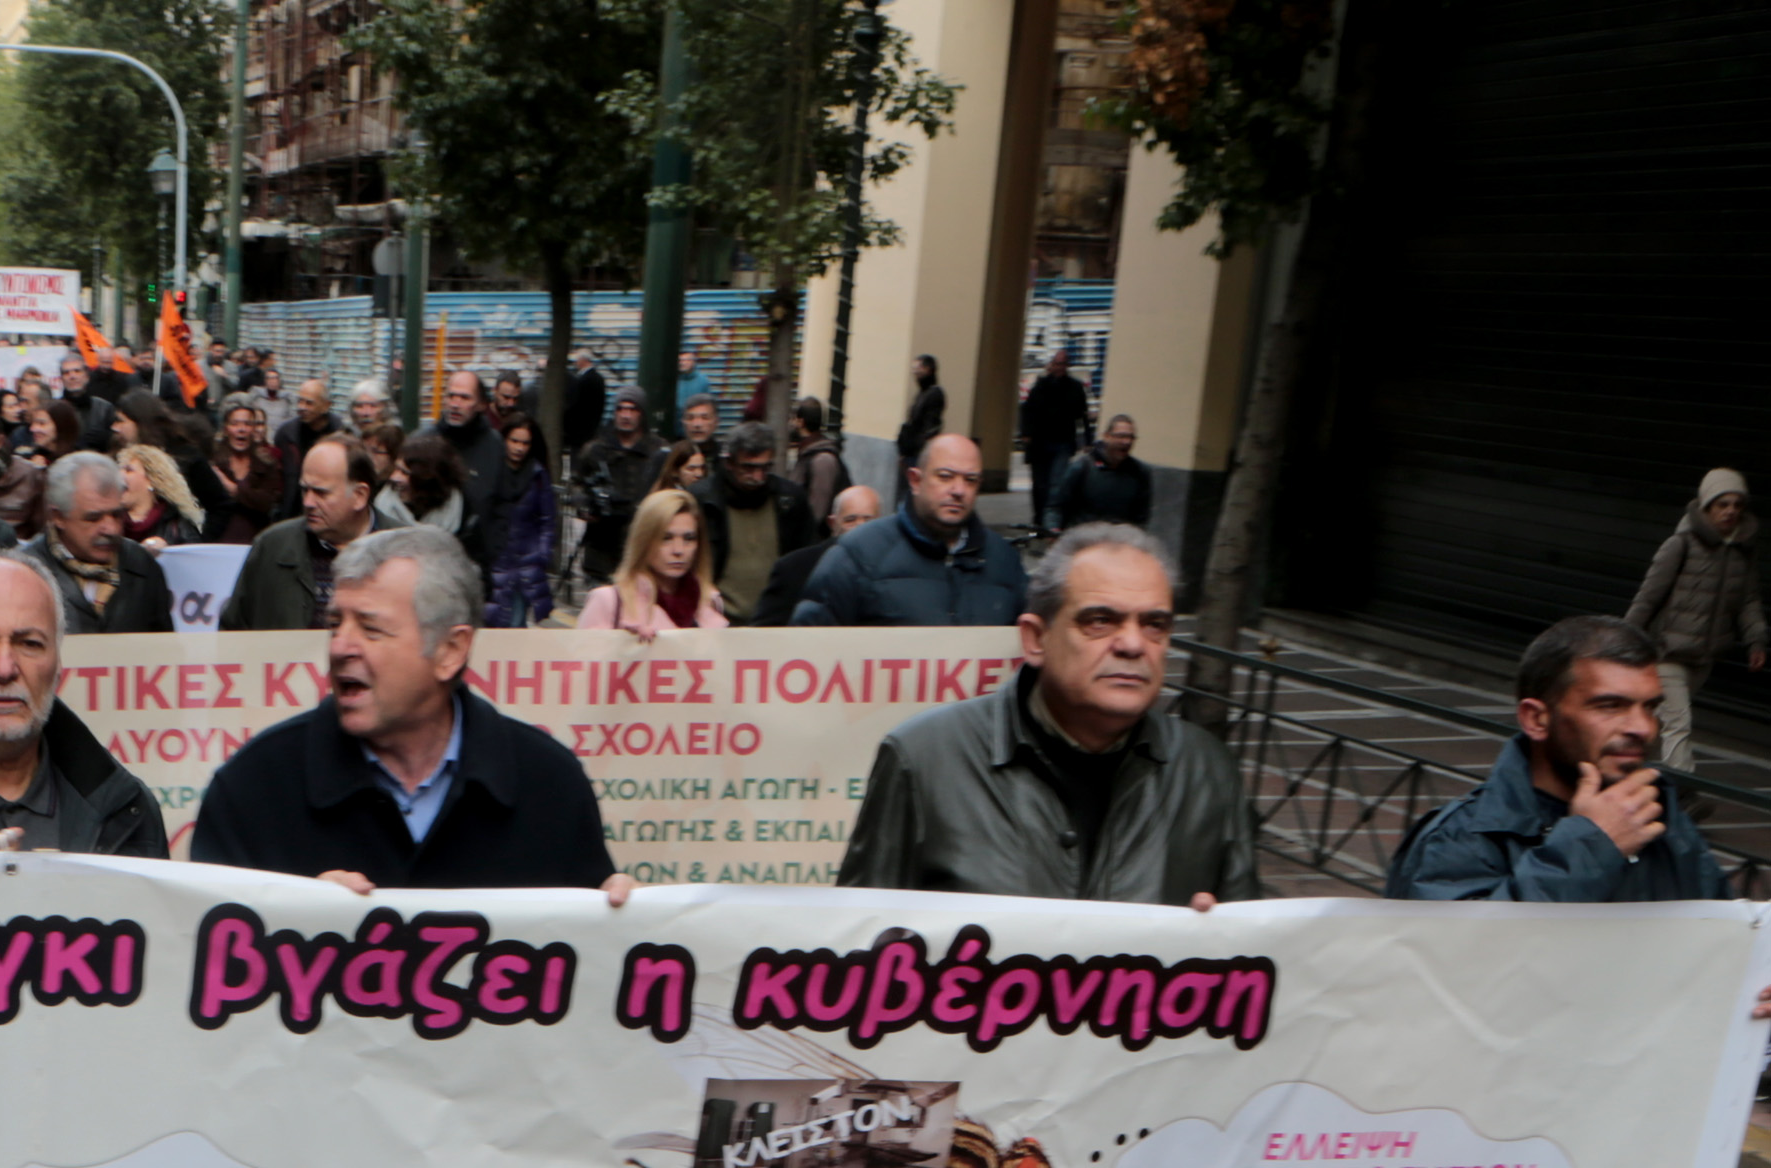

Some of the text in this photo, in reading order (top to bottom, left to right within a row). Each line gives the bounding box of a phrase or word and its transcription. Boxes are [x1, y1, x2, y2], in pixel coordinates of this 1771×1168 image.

[733, 658, 1024, 704] ΠΟΛΙΤΙΚΕ
[570, 721, 762, 757] ΣΧΟΛΕΙΟ
[720, 778, 819, 801] ΑΓΩΓΗ
[190, 903, 577, 1041] βγάζει
[615, 942, 695, 1043] η
[731, 923, 1278, 1054] κυβέρνηση
[1262, 1131, 1418, 1161] ΕΛΛΕΙΨΗ
